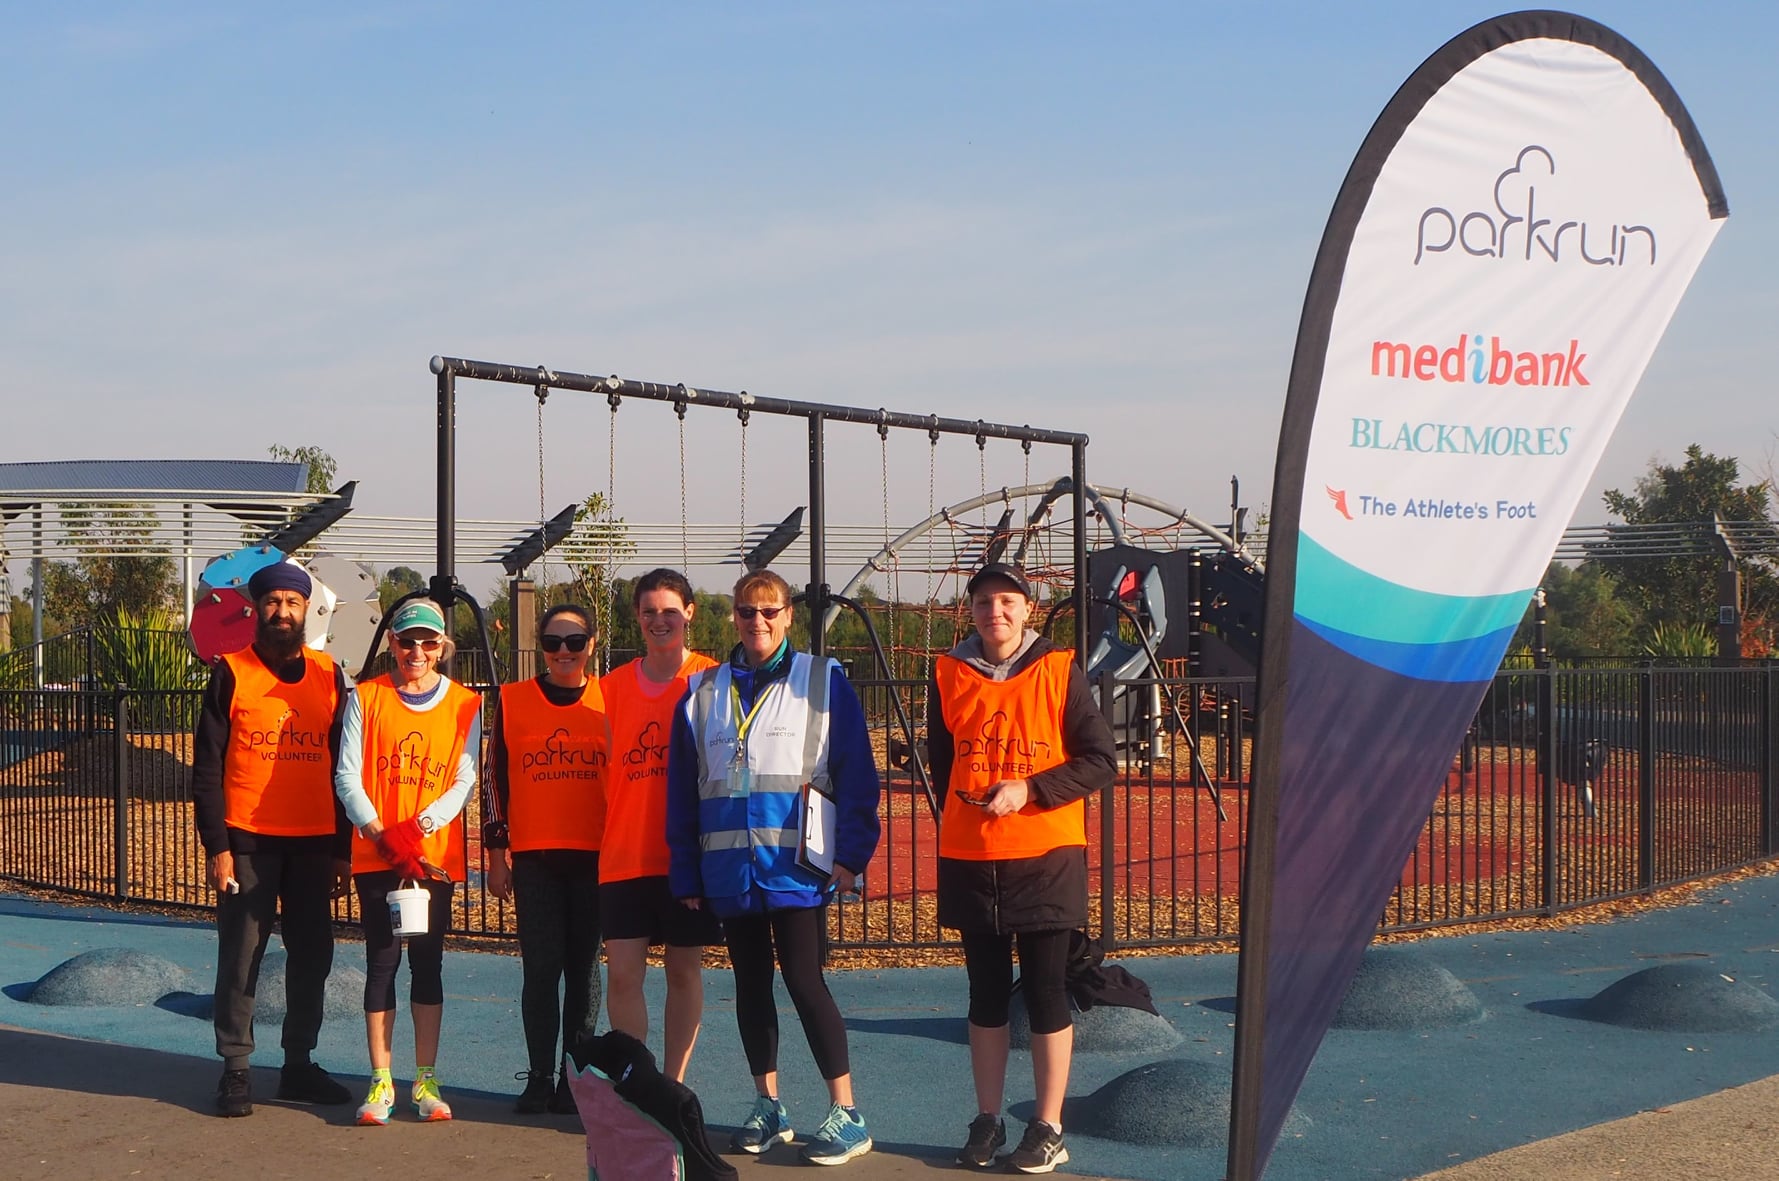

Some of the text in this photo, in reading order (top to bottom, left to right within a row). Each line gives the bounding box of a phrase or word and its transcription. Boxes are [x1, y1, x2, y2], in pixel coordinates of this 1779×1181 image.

[1413, 144, 1657, 266] parkrun
[1371, 333, 1591, 387] medibank
[1349, 417, 1572, 456] BLACKMORES
[1359, 495, 1537, 519] The Athlete's Foot
[522, 727, 607, 774] parkrun
[622, 721, 669, 767] parkr
[261, 751, 323, 762] VOLUNTEER
[970, 761, 1035, 775] OLUNTEER
[388, 775, 436, 792] VLUNTER
[531, 770, 599, 782] VOLUNTEER
[627, 767, 669, 782] VOLUNT
